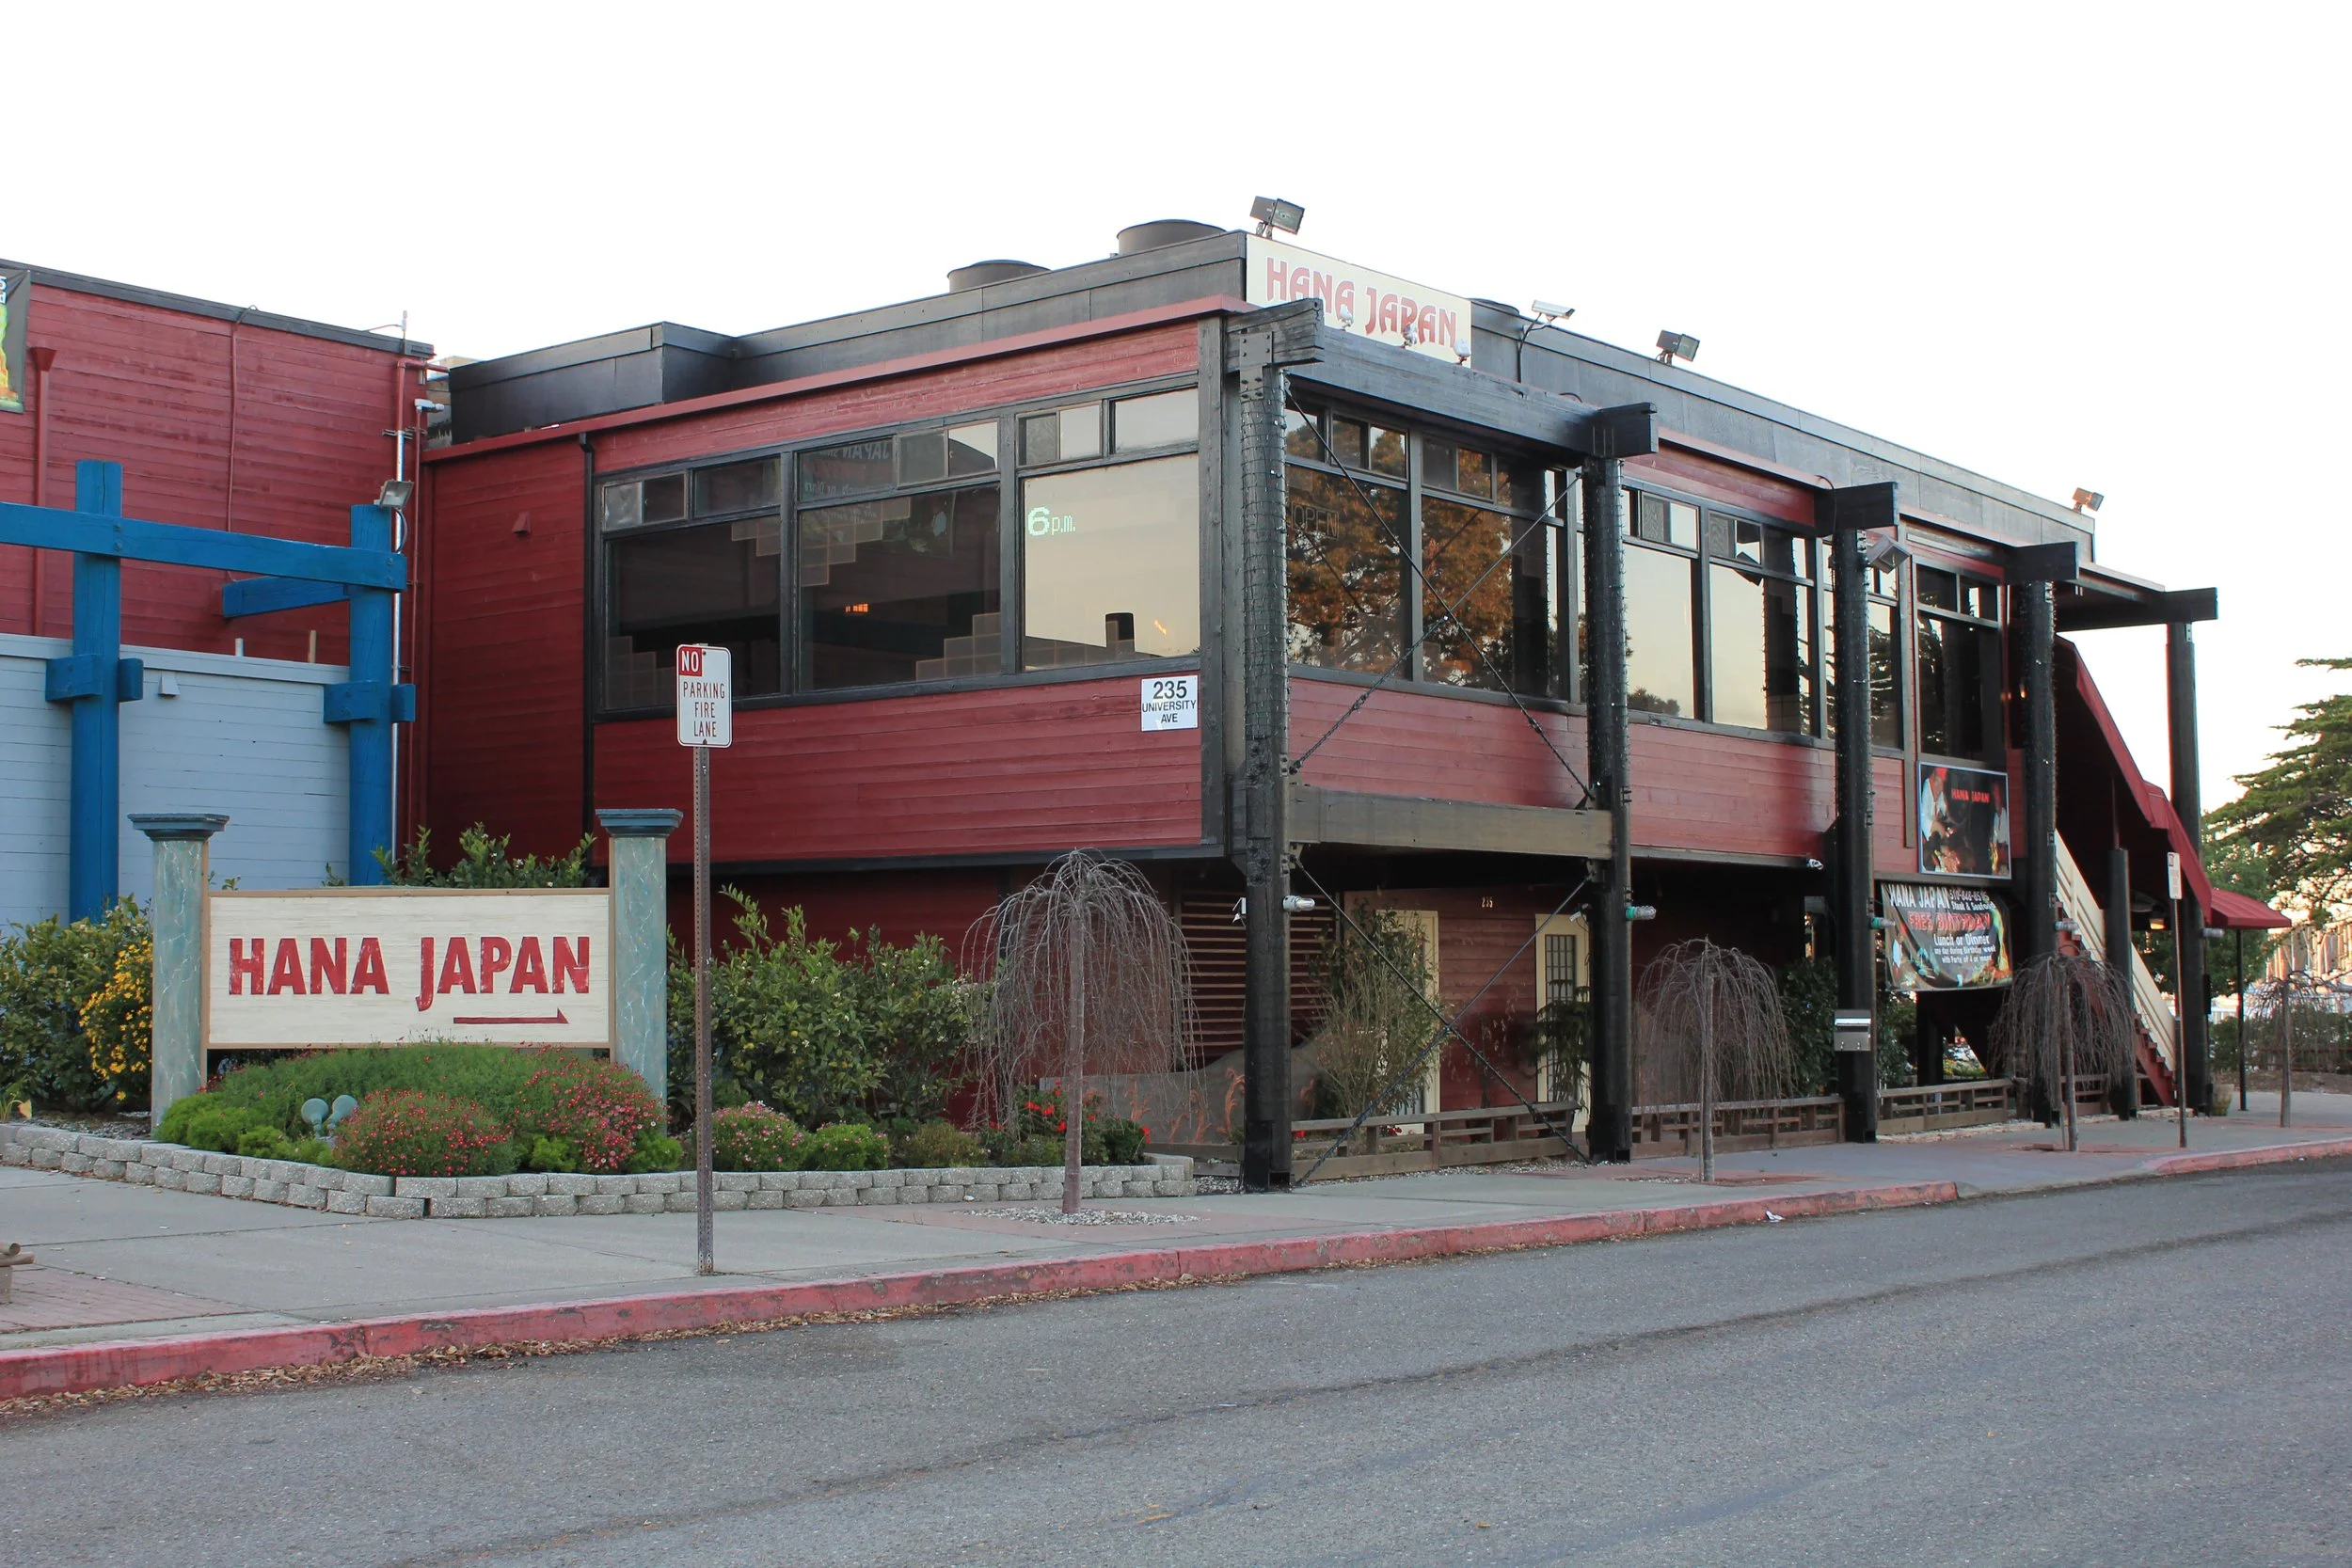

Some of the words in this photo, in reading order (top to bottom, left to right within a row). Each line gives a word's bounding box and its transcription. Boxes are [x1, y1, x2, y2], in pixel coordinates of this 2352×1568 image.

[1266, 257, 1355, 325] HANA
[1365, 287, 1457, 348] JAPAN
[1294, 505, 1338, 537] OPEN
[681, 650, 699, 673] NO
[683, 681, 725, 699] PARKING
[1152, 680, 1187, 700] 235
[694, 701, 716, 719] FIRE
[1141, 699, 1197, 713] UNIVERSITY
[1161, 713, 1179, 723] AVE
[693, 721, 717, 737] LANE
[1951, 788, 1969, 801] HANA
[1888, 884, 1916, 908] HANA
[1918, 886, 1950, 910] JAPAN
[1908, 911, 1934, 931] FREE
[1933, 933, 1955, 946] Lunch
[1955, 936, 1963, 946] or
[1964, 933, 1991, 945] Dinner
[230, 938, 390, 995] HANA
[415, 936, 590, 1011] JAPAN
